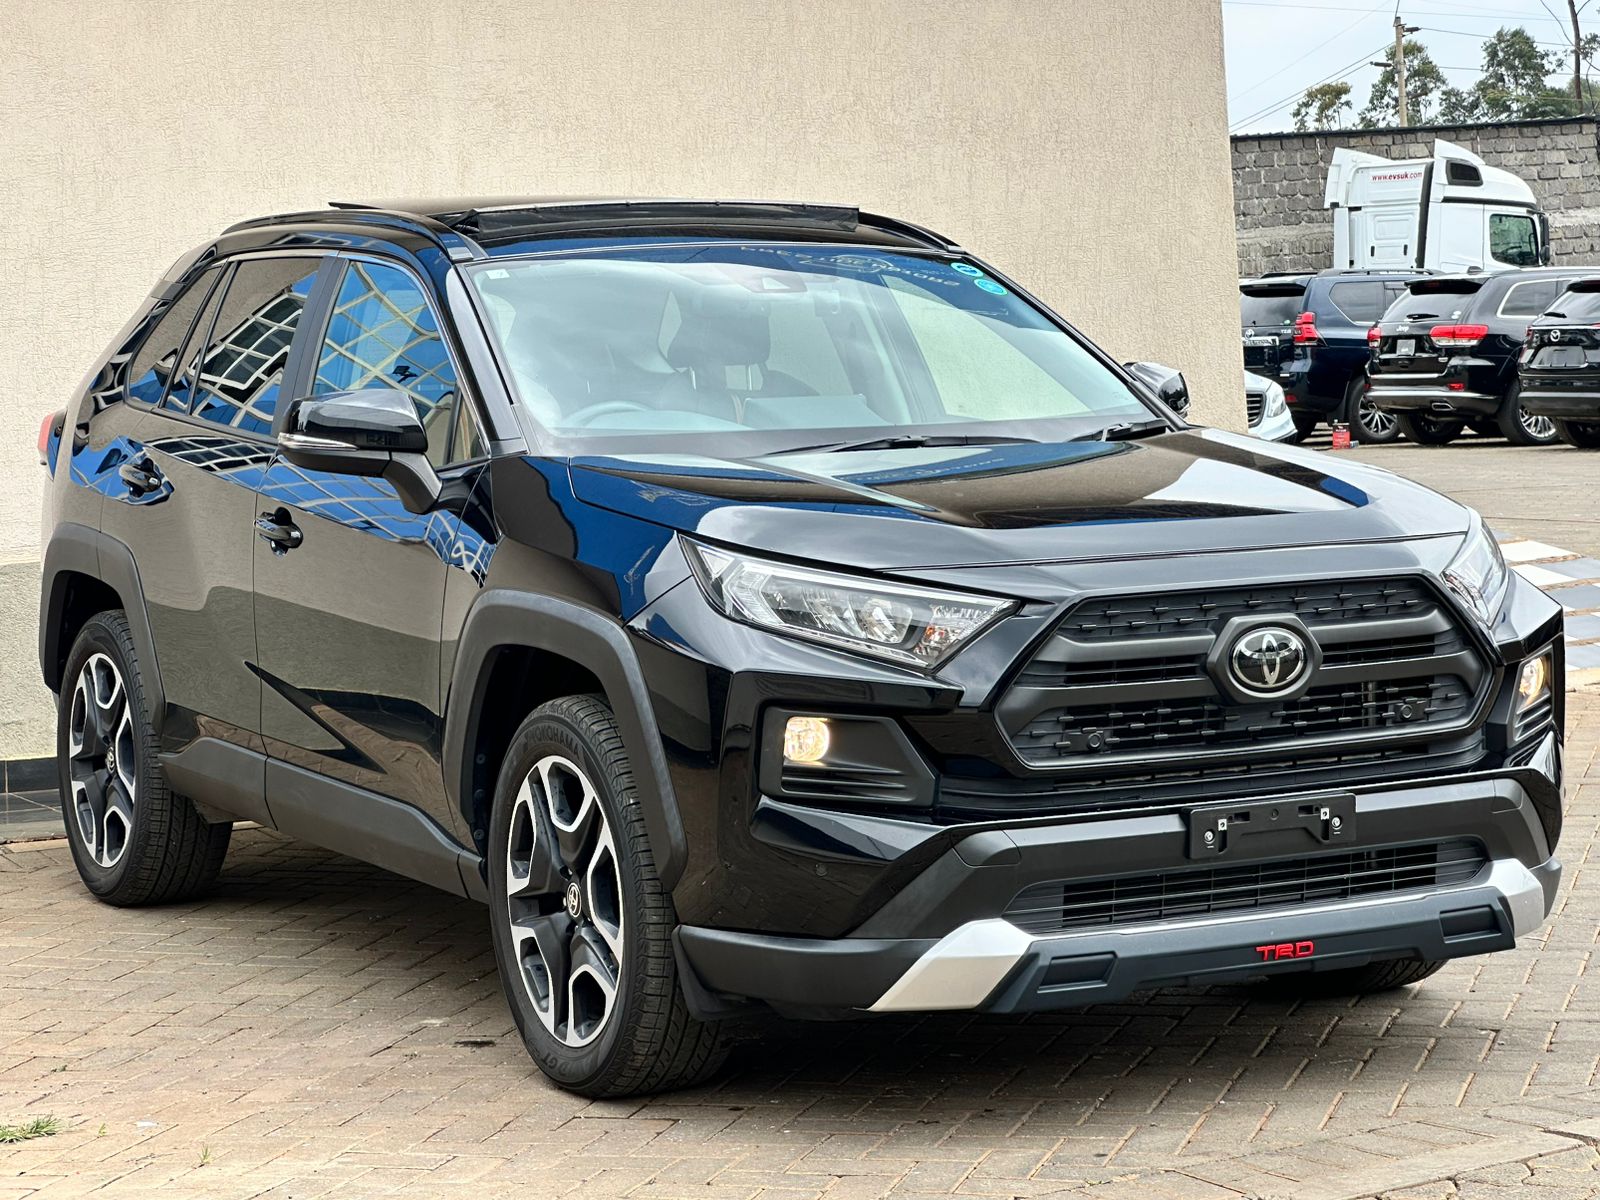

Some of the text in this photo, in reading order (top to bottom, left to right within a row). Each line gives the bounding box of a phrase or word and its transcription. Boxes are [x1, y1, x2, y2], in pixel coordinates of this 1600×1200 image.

[1372, 172, 1422, 181] www.evsuk.com
[530, 725, 578, 755] YOKOHAMA
[1256, 941, 1314, 960] TRD
